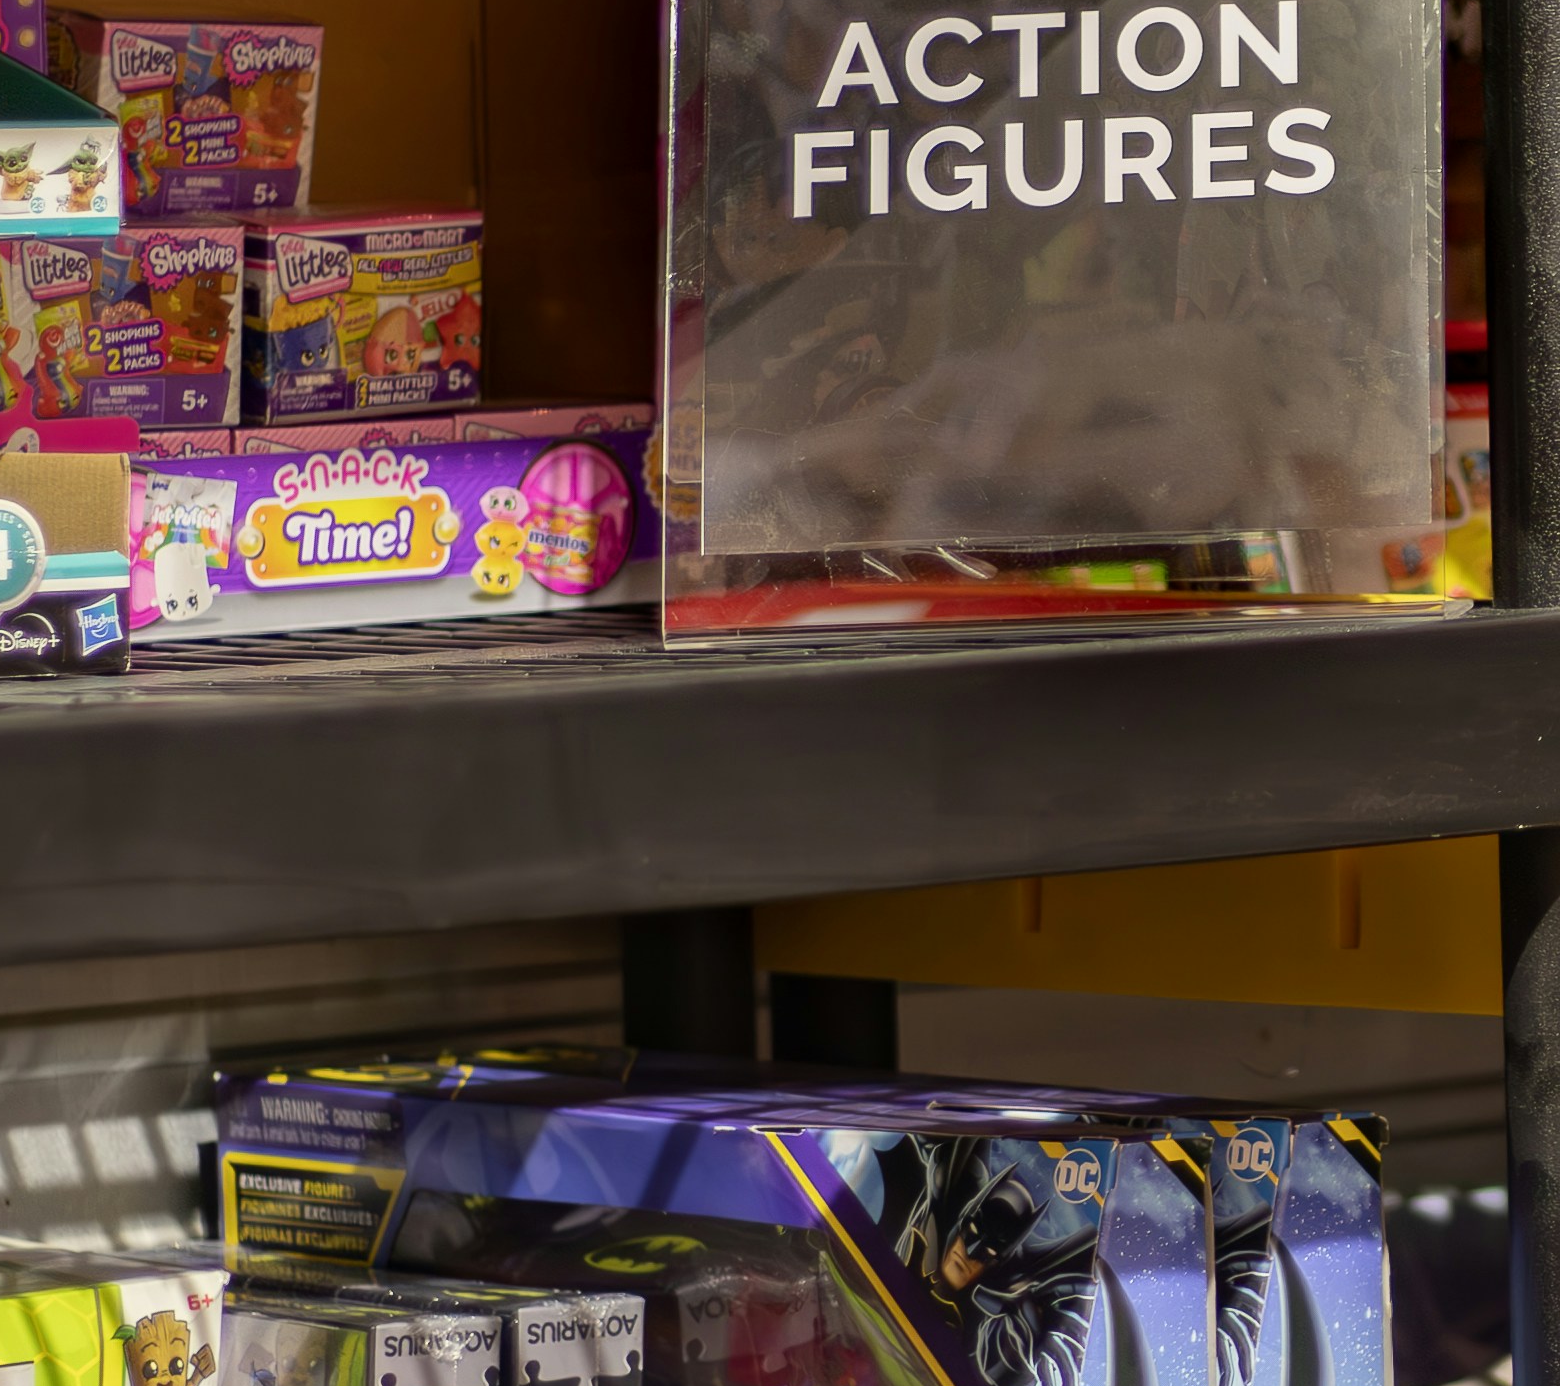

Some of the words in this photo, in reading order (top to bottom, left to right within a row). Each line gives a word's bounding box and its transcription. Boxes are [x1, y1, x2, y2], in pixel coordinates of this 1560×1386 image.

[232, 36, 316, 74] Shopkins
[816, 0, 1301, 109] ACTION
[168, 120, 183, 145] 2
[185, 140, 199, 165] 2
[792, 107, 1336, 219] FIGURES
[252, 183, 279, 205] 5+
[149, 238, 236, 277] Shopkins
[88, 328, 102, 352] 2
[105, 324, 161, 344] SHOPKINS
[108, 348, 122, 372] 2
[123, 342, 148, 357] MINI
[123, 354, 161, 373] PACKS
[447, 368, 473, 391] 5+
[181, 390, 209, 412] 5+
[286, 510, 413, 564] Time!
[529, 530, 590, 553] mentos
[80, 614, 119, 631] Hasbro
[1229, 1138, 1271, 1172] DC
[1060, 1159, 1099, 1194] DC
[186, 1293, 214, 1311] 6+
